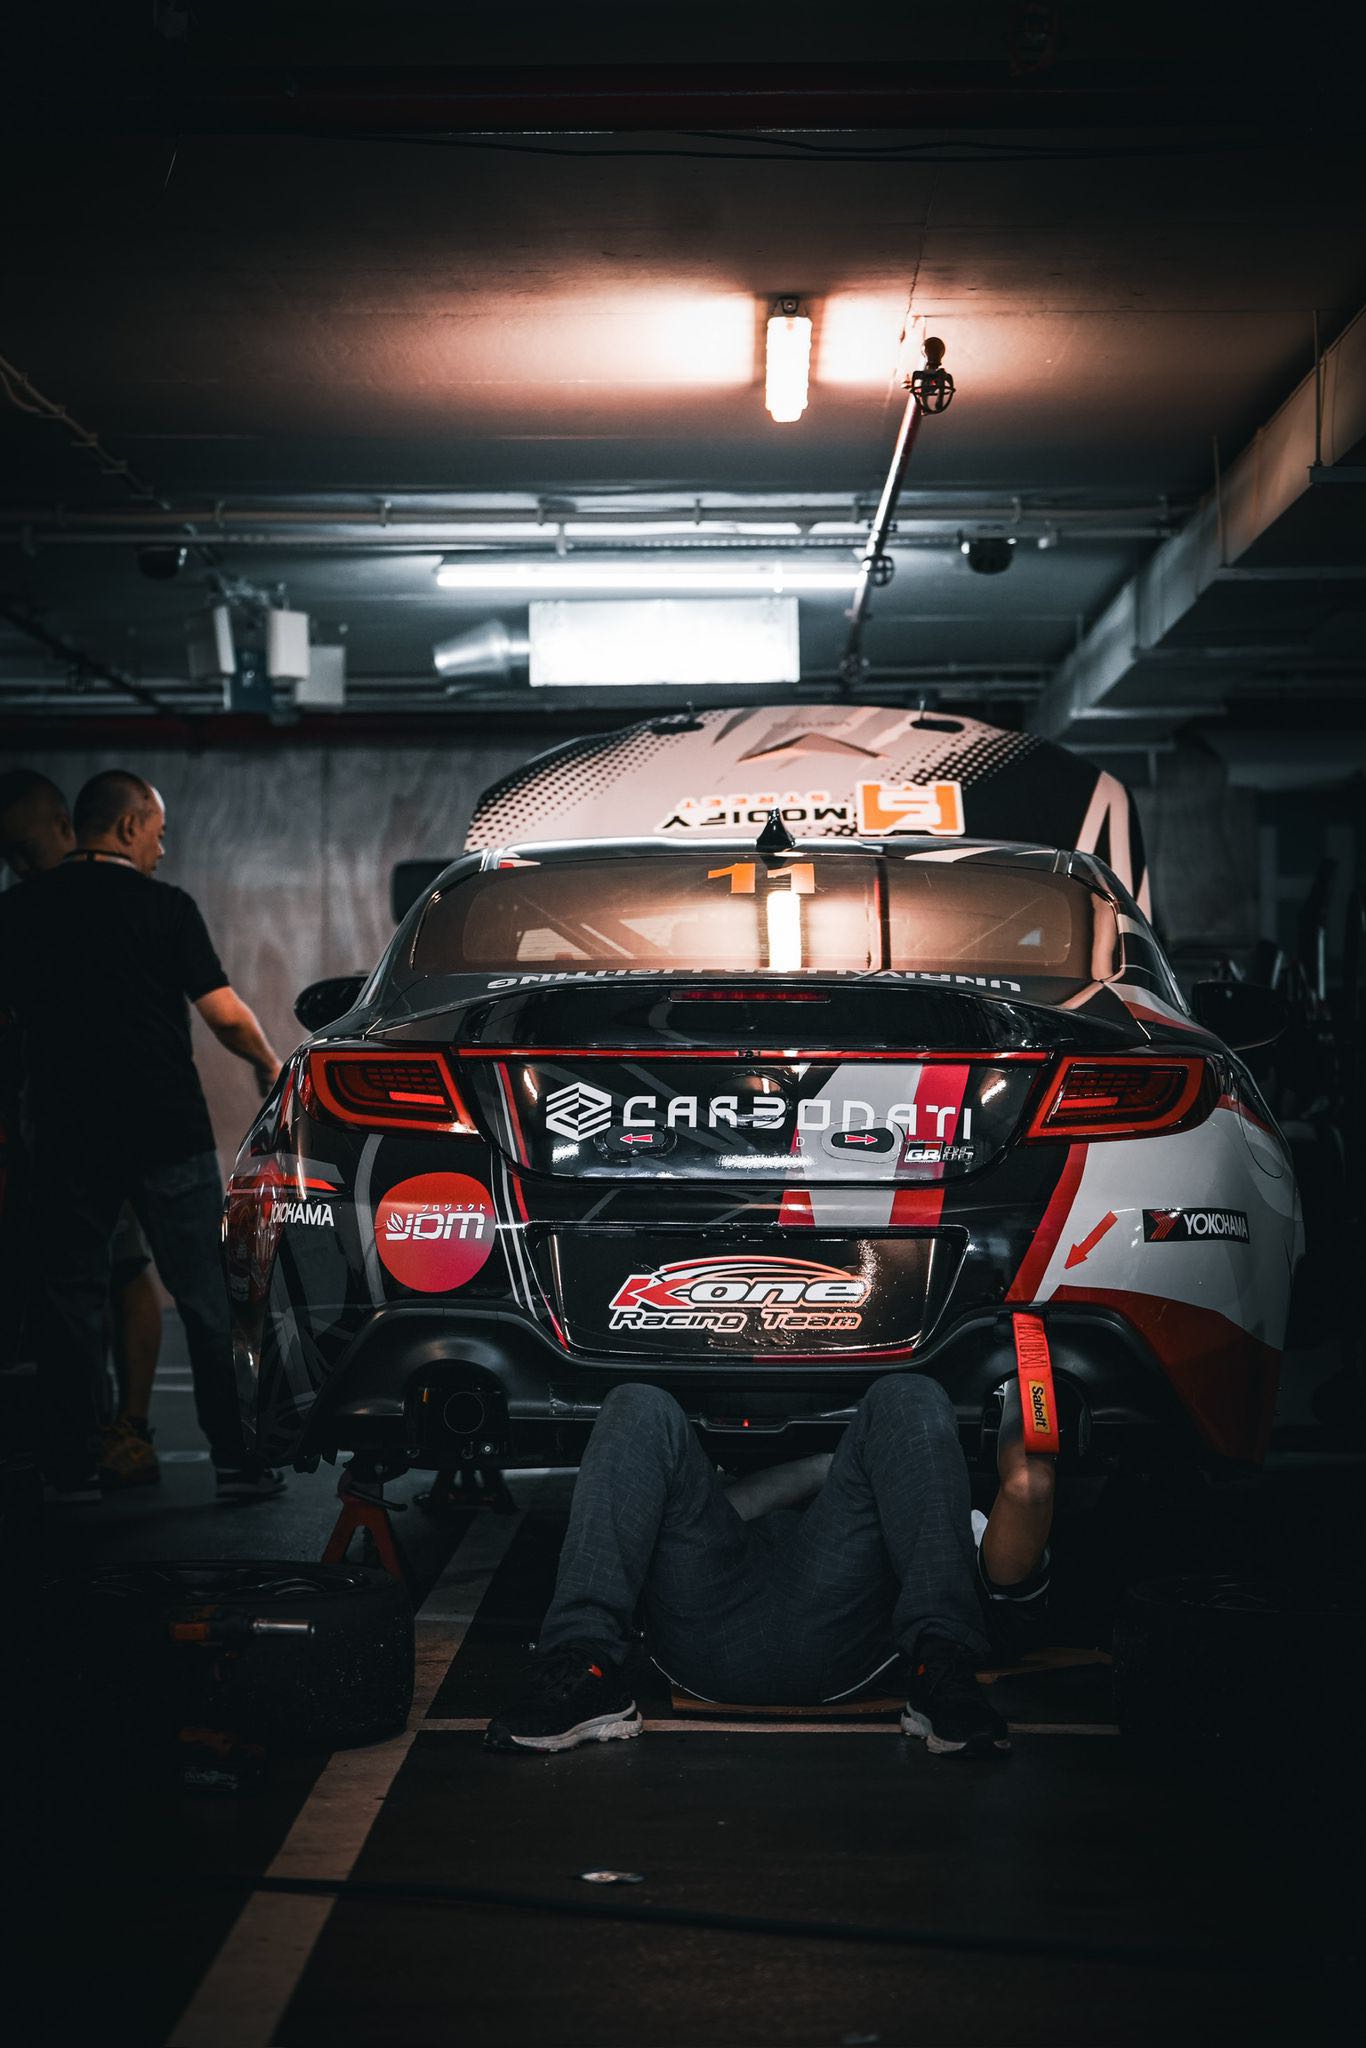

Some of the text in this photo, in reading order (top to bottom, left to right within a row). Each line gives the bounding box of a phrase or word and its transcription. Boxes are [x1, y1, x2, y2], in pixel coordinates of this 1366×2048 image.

[684, 794, 825, 809] STREET
[662, 807, 847, 829] MODIFY
[708, 863, 815, 893] 11
[1183, 1213, 1248, 1239] YOKOHAMA
[609, 1309, 862, 1333] Racing Team
[1032, 1386, 1047, 1427] Sabelt
